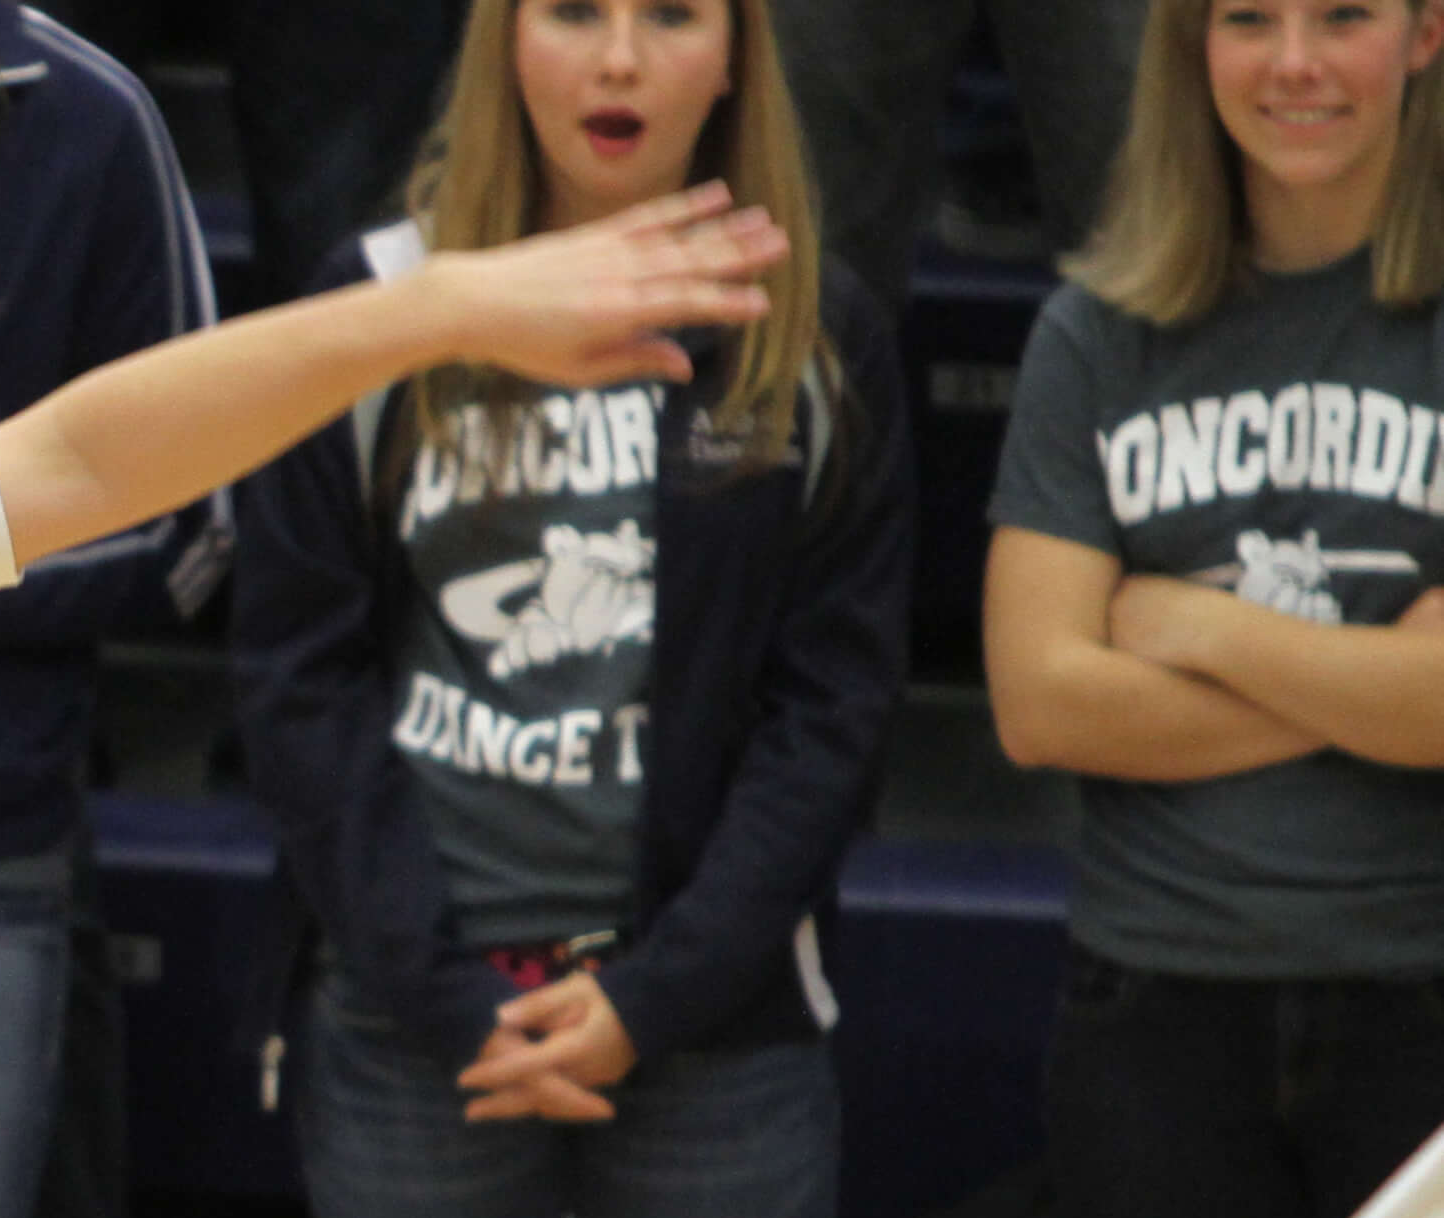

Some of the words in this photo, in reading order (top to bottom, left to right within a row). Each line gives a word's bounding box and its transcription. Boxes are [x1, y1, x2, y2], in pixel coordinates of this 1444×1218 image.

[399, 383, 665, 541] ONCOR
[1097, 381, 1444, 526] ONCORDI
[392, 672, 602, 785] DANCE
